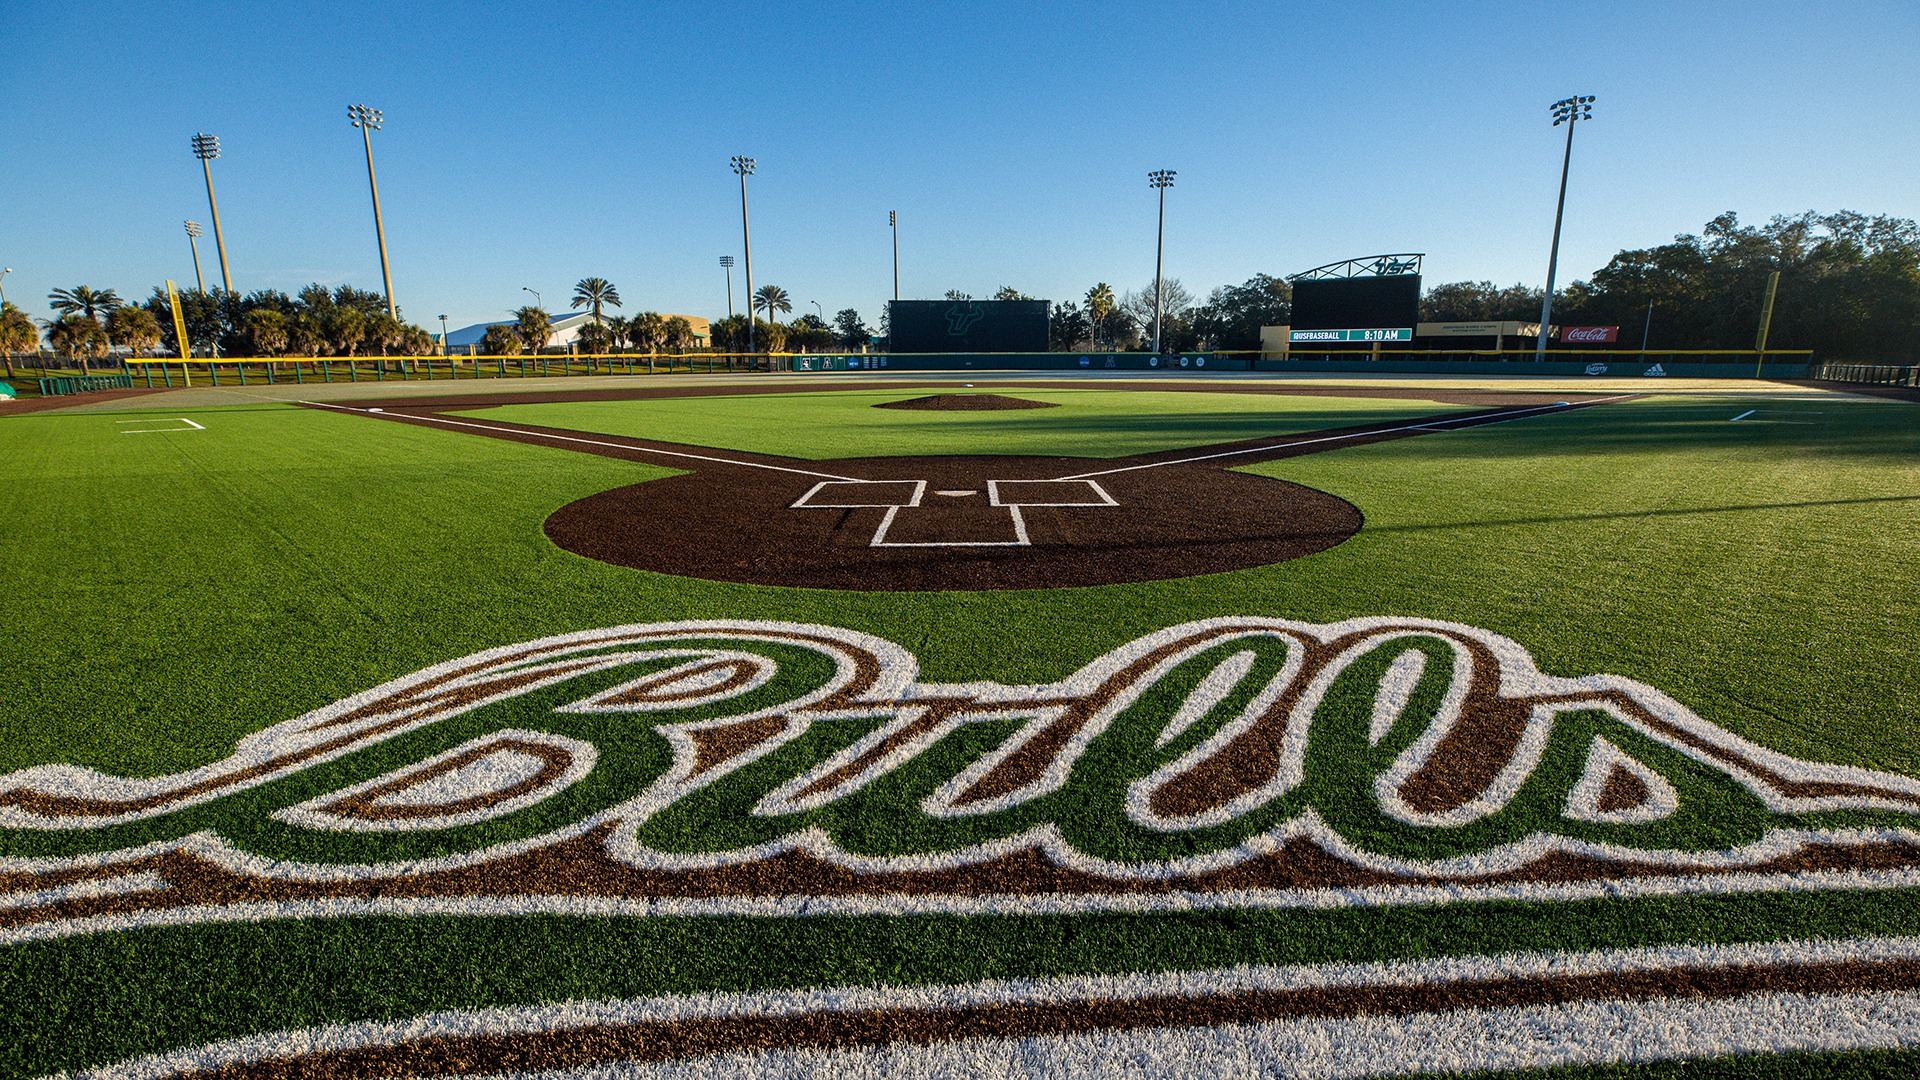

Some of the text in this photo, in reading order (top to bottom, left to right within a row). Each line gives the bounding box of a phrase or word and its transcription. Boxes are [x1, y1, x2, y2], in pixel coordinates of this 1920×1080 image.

[1375, 257, 1417, 275] USF
[1293, 331, 1340, 340] @USFBASEBALL
[1364, 330, 1399, 340] 8:10 AM
[0, 615, 1920, 882] Bulls
